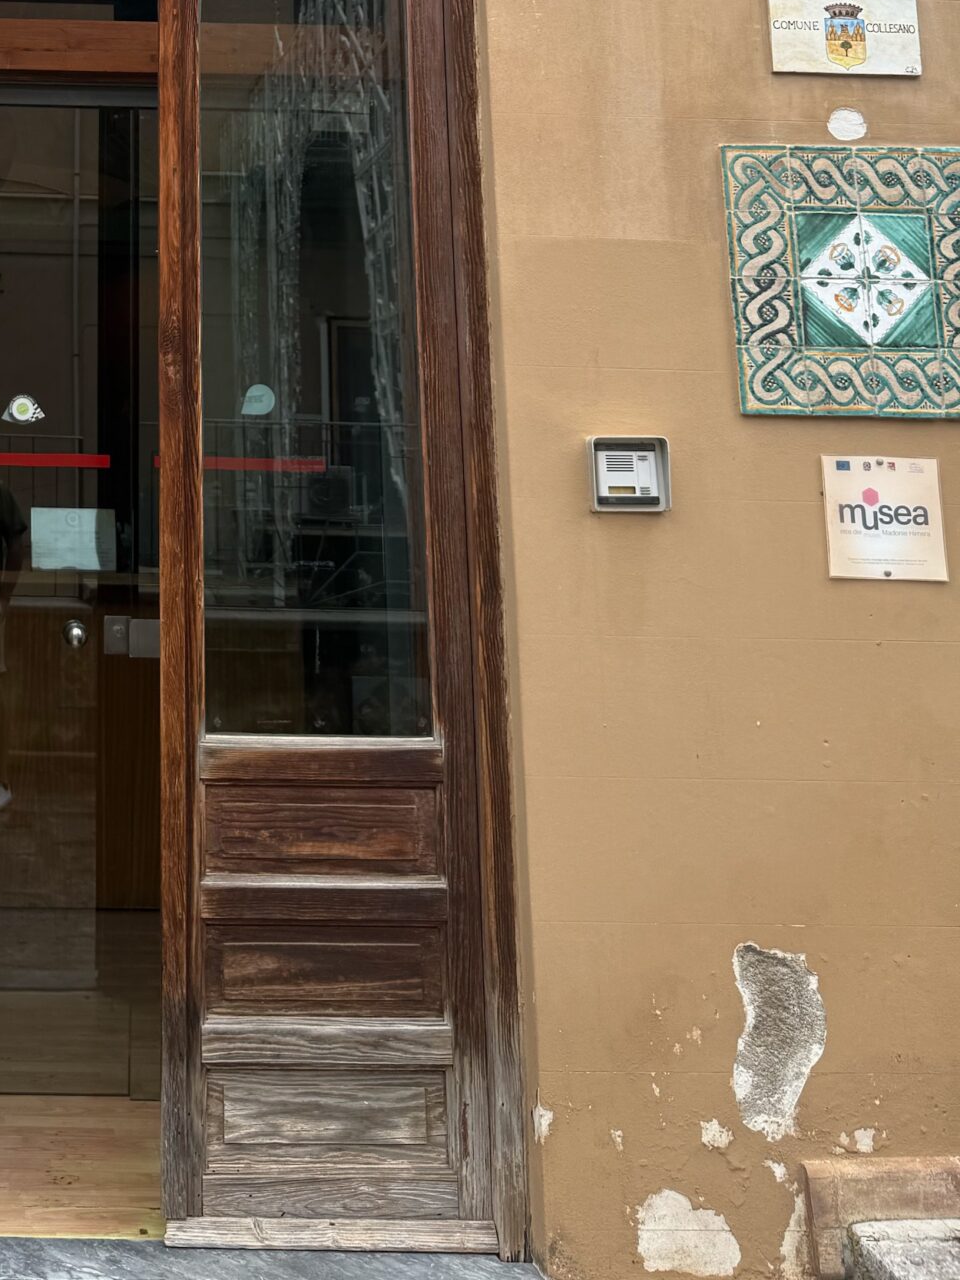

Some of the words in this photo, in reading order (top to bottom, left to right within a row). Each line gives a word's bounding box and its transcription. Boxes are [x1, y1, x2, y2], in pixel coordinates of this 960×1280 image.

[772, 19, 820, 32] COMUNE
[865, 22, 916, 35] COLLESANO
[838, 503, 929, 530] musea
